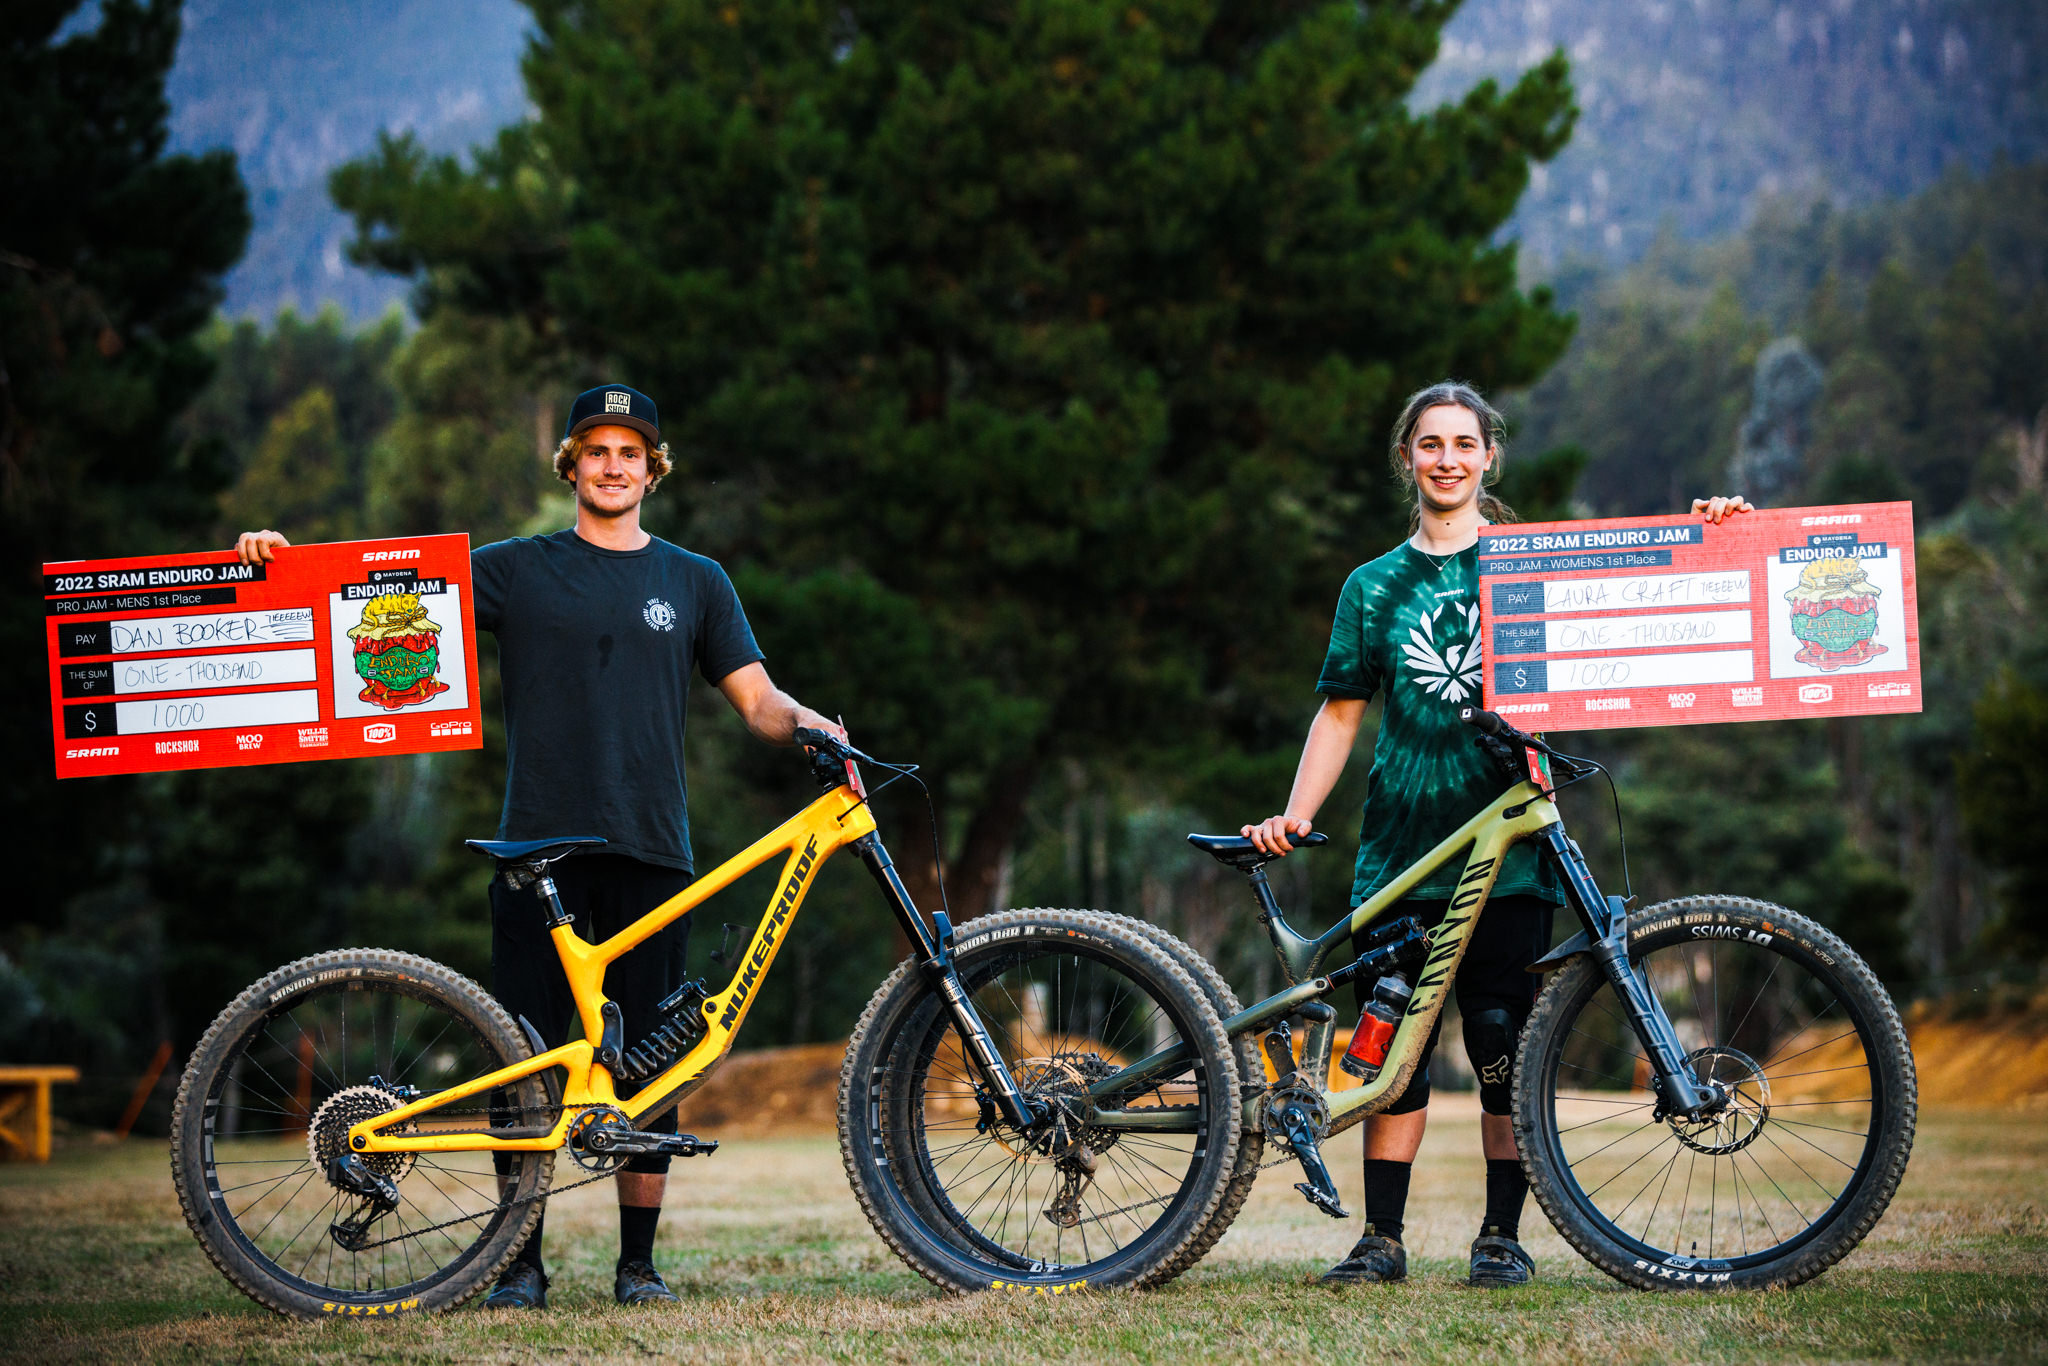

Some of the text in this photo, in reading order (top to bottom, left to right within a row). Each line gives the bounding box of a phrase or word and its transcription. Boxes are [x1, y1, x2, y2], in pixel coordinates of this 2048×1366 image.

[608, 394, 628, 405] ROCK
[1801, 514, 1862, 526] SRAM
[1489, 529, 1690, 552] 2022 SRAM ENDURO JAM
[362, 549, 421, 562] SRAM
[1785, 544, 1881, 561] ENDURO JAM
[1490, 562, 1514, 573] PRO
[1516, 560, 1541, 572] JAM
[1550, 557, 1604, 569] WOMENS
[1607, 555, 1623, 567] 1st
[1626, 554, 1656, 566] Place
[55, 565, 253, 592] 2022 SRAM ENDURO JAM
[347, 580, 440, 598] ENDURO JAM
[1434, 589, 1464, 598] SRAM
[1546, 583, 1610, 608] LAURA
[1622, 577, 1698, 602] CRAFT
[56, 601, 80, 612] PRO
[82, 599, 108, 611] JAM
[116, 596, 150, 609] MENS
[153, 595, 169, 606] 1st
[172, 593, 201, 605] Place
[1508, 594, 1529, 605] PAY
[75, 634, 96, 645] PAY
[111, 625, 163, 651] DAN
[173, 618, 267, 645] BOOKER
[1501, 628, 1539, 638] THE SUM
[1560, 624, 1610, 648] ONE
[1631, 620, 1716, 644] THOUSAND
[1514, 639, 1526, 648] OF
[368, 654, 430, 668] ENDURO
[69, 670, 108, 680] THE SUM
[124, 663, 169, 687] ONE
[186, 660, 263, 683] THOUSAND
[380, 667, 417, 679] JAM
[1514, 668, 1527, 688] $
[1570, 661, 1630, 685] 1000
[83, 681, 95, 690] OF
[1586, 697, 1631, 711] ROCKSHOX
[1668, 692, 1696, 703] MOO
[153, 702, 204, 727] 1000
[1495, 703, 1549, 714] SRAM
[84, 710, 97, 732] $
[431, 721, 472, 729] GoPro
[236, 733, 263, 744] MOO
[367, 727, 393, 739] 100%
[66, 747, 120, 758] SRAM
[155, 739, 200, 754] ROCKSHOX
[239, 742, 261, 750] BREW
[718, 833, 819, 1031] NUKEPROOF
[1632, 915, 1682, 940] MINION
[1407, 857, 1496, 1016] CANYON
[1691, 925, 1773, 947] DT SWISS
[269, 976, 316, 1003] MINION
[1634, 1260, 1731, 1283] MAXXIS
[322, 1298, 420, 1315] MAXXIS
